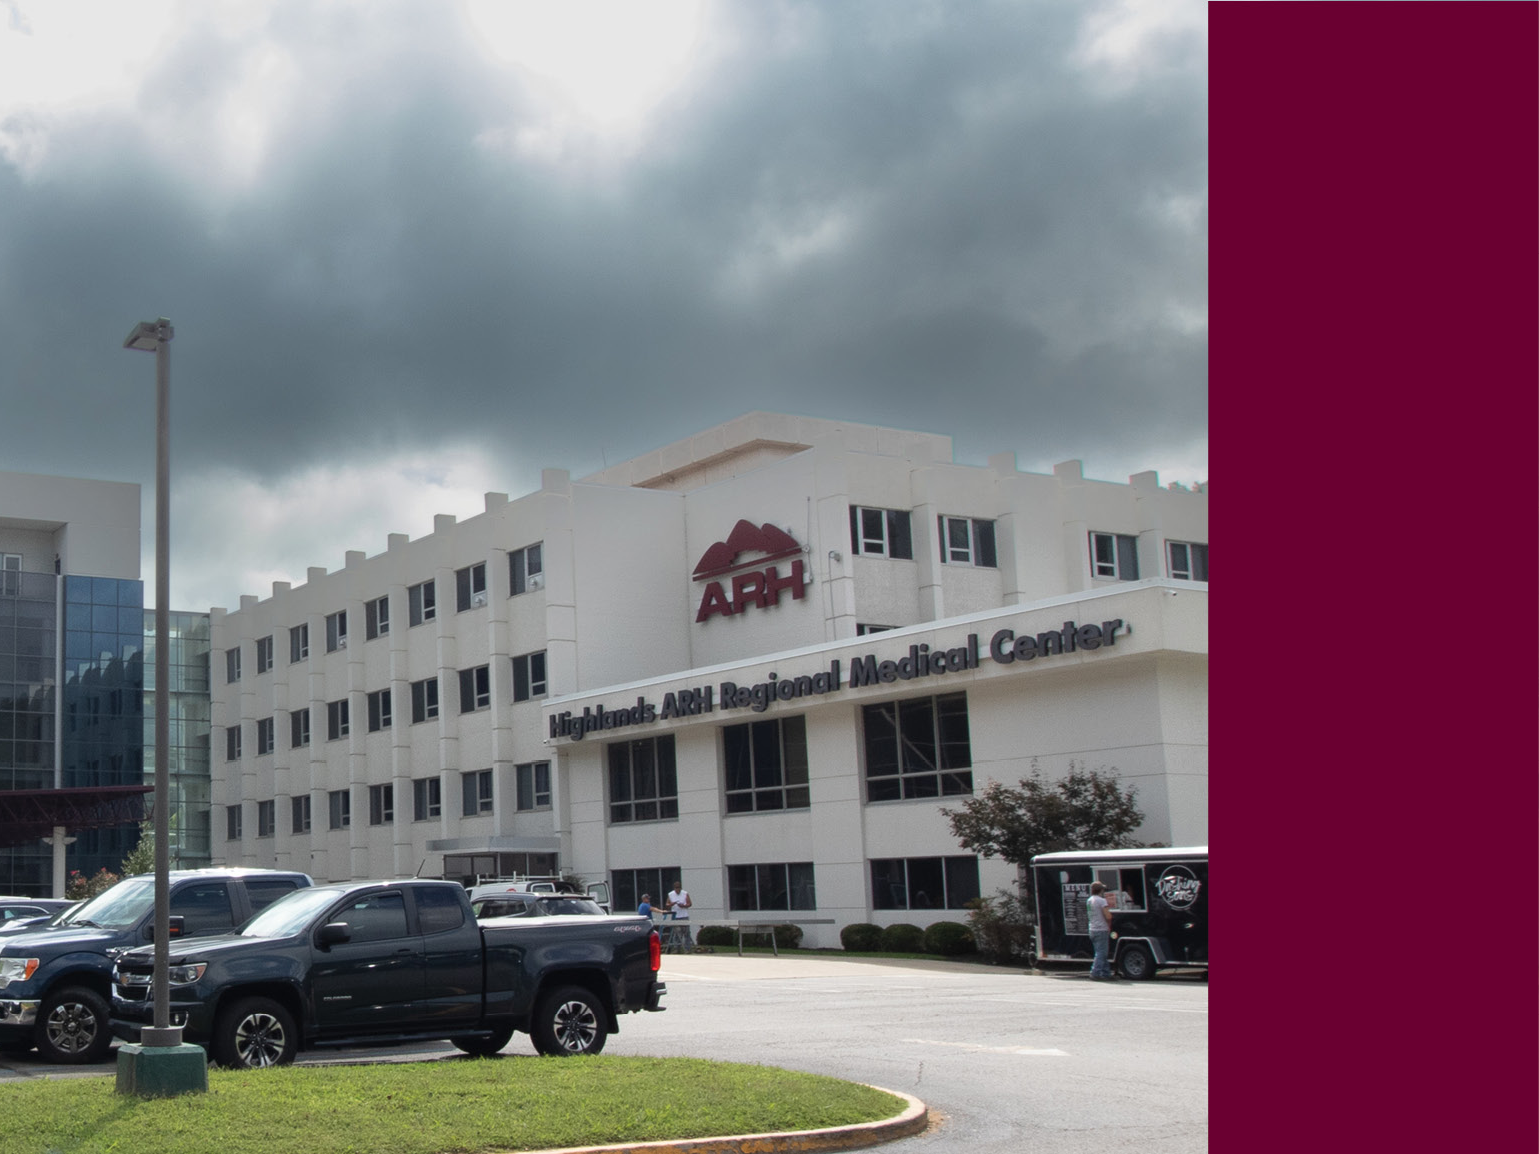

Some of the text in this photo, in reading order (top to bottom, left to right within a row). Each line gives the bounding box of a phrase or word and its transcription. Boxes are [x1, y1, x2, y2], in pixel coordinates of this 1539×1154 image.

[696, 558, 805, 624] ARH
[548, 618, 1124, 741] Highlands ARH Regional Medical Center
